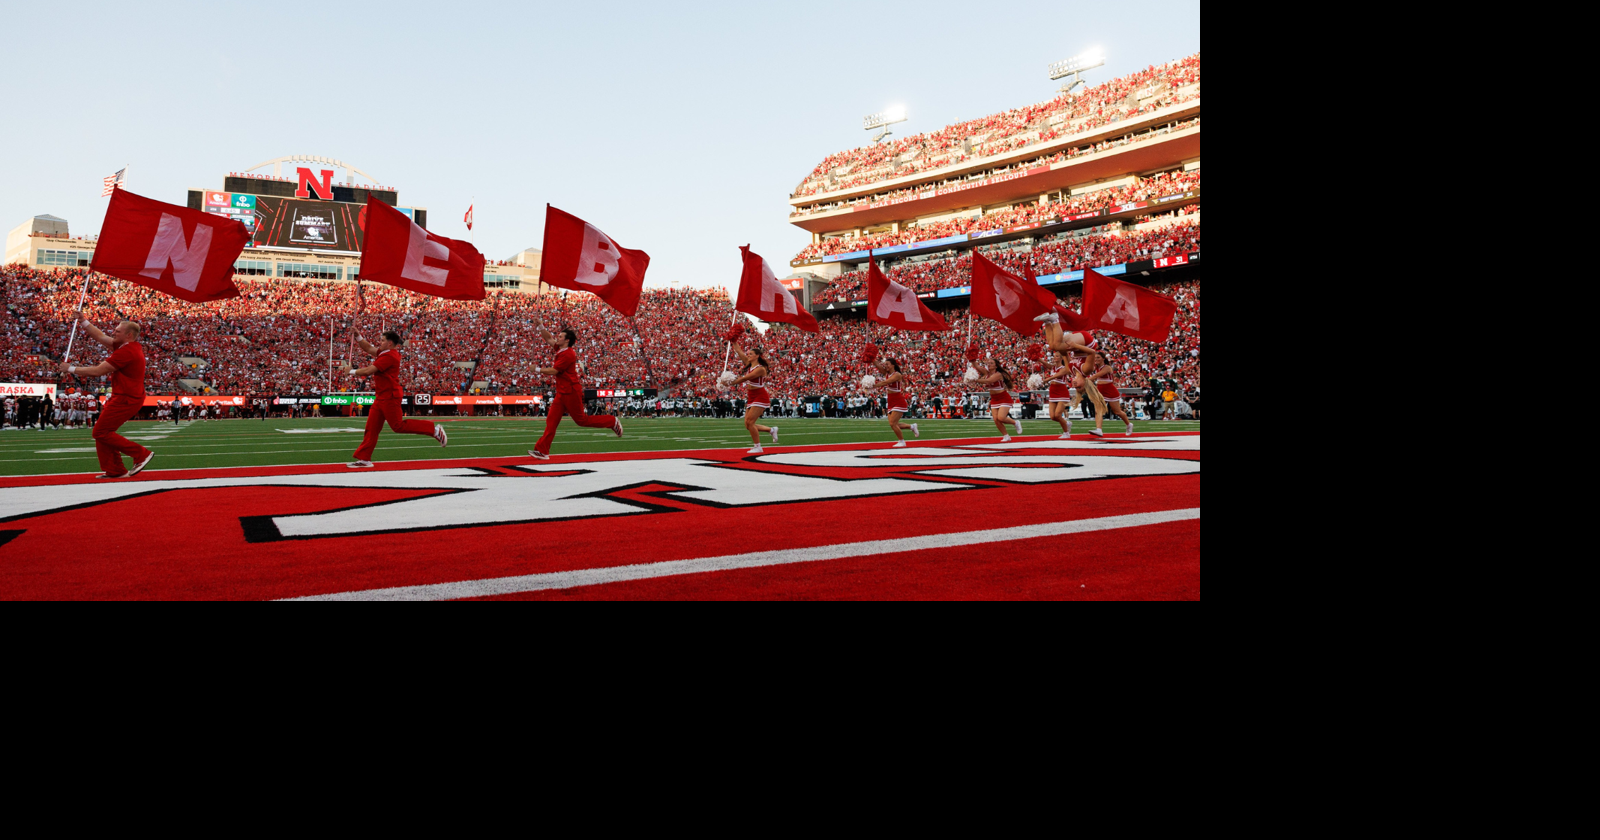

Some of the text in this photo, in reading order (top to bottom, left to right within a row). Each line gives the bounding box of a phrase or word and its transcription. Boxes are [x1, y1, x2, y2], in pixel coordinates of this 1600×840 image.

[229, 171, 395, 192] MEMORIAL STADIUM
[295, 167, 334, 200] N
[869, 201, 889, 209] NCAA
[890, 194, 918, 205] RECORD
[937, 180, 988, 195] CONSECUTIVE
[990, 170, 1028, 184] SELLOUTS
[138, 212, 213, 292] N
[400, 220, 450, 287] E
[574, 222, 622, 286] B
[1159, 258, 1168, 267] N
[876, 279, 923, 323] A
[1100, 285, 1140, 331] A
[417, 395, 429, 404] 25
